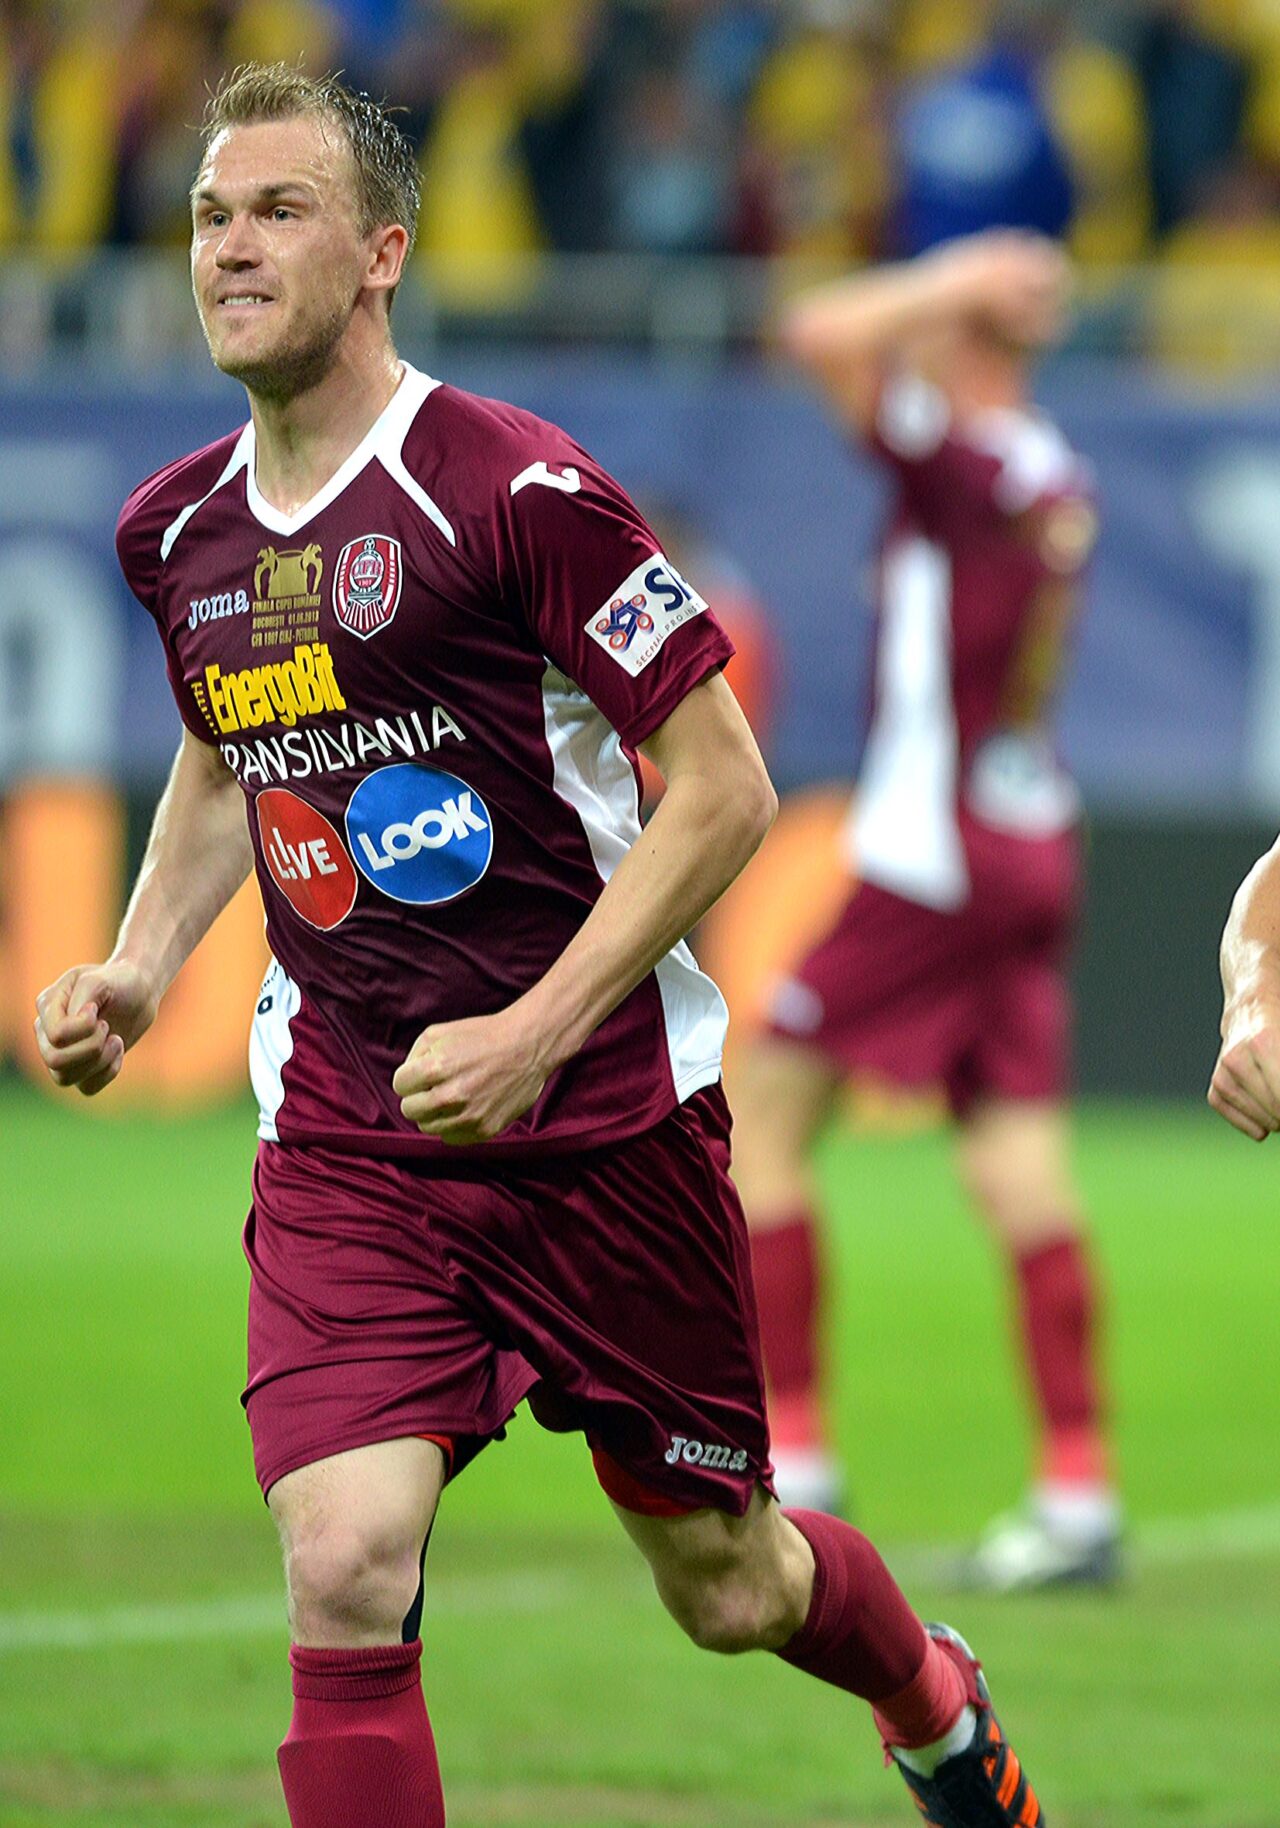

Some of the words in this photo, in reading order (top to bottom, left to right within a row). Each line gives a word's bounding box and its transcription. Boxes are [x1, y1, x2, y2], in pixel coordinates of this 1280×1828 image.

[645, 562, 694, 612] S
[664, 613, 684, 632] PRO
[205, 642, 348, 734] EnergoBit
[220, 705, 467, 785] RANSILVANIA
[357, 791, 489, 872] LOOK
